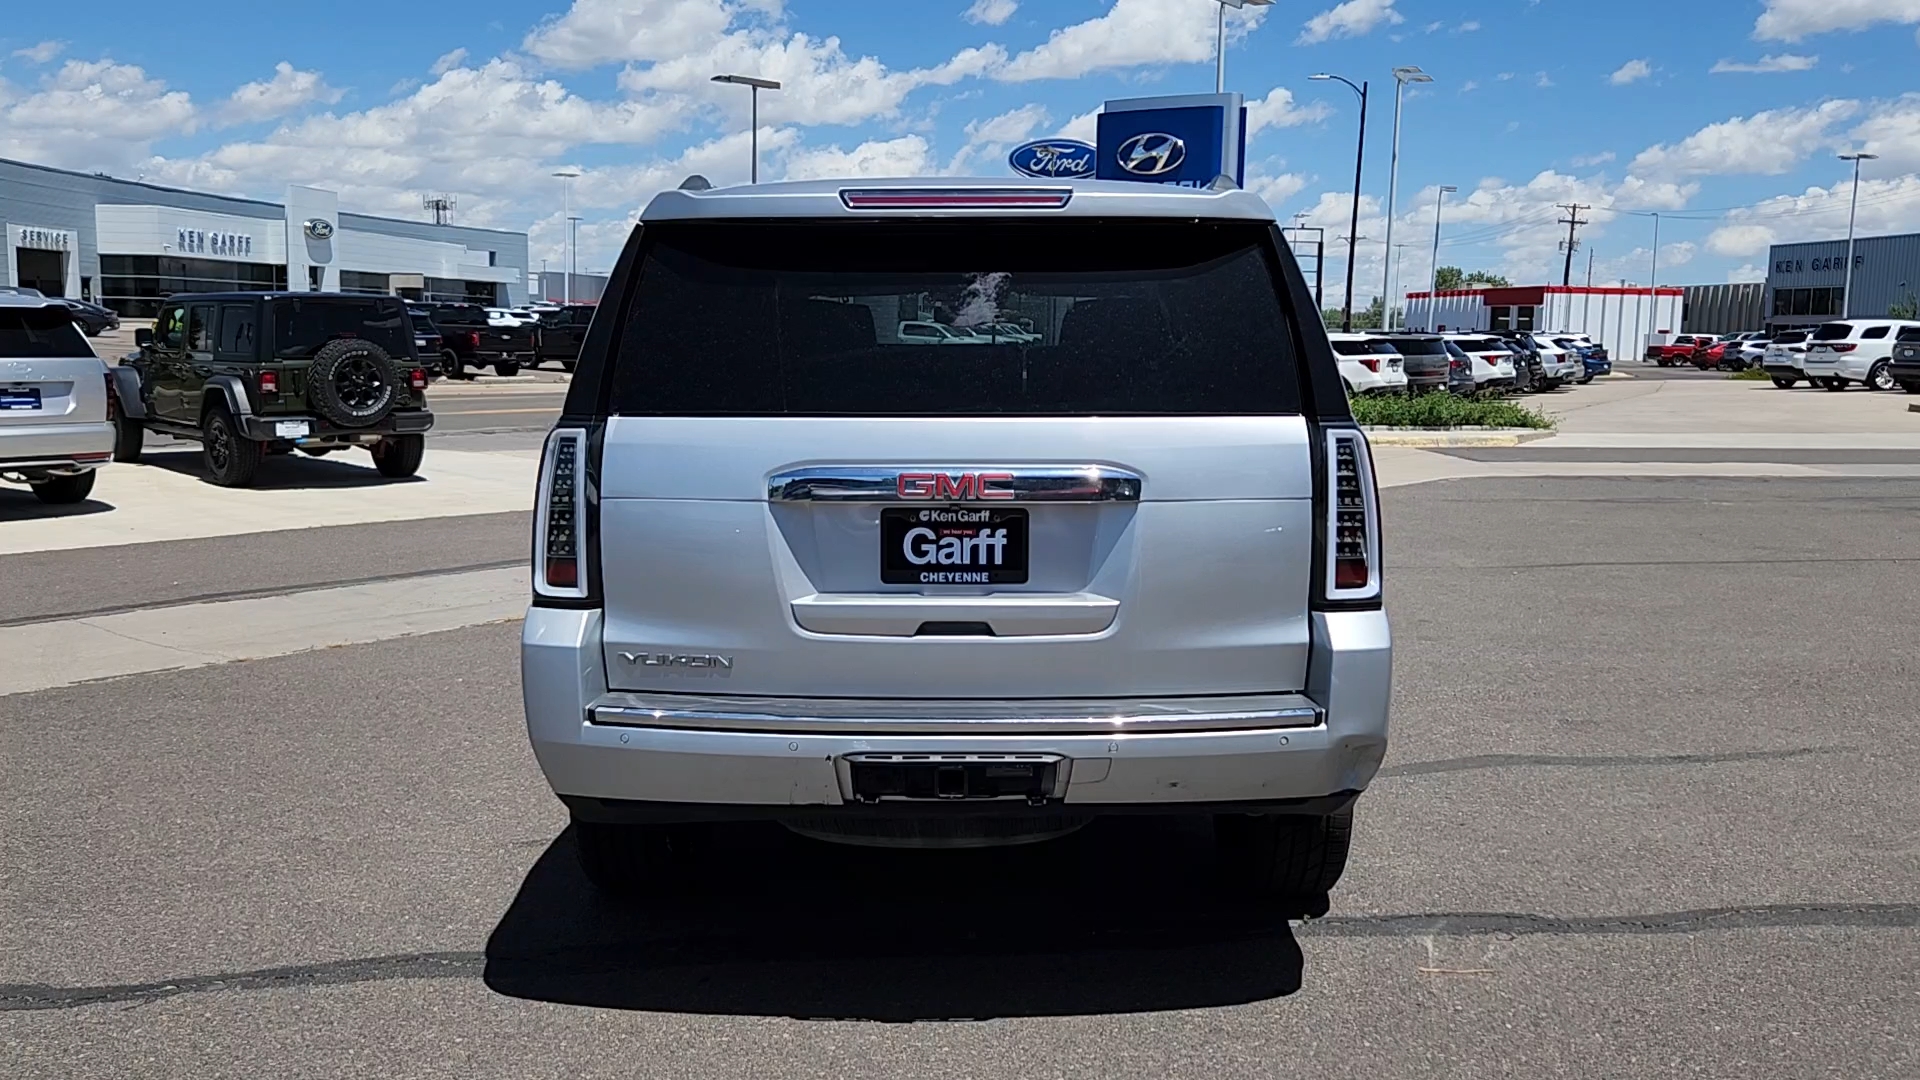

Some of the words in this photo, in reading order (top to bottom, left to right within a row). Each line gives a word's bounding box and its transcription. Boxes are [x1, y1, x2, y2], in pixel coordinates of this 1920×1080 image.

[1030, 147, 1090, 174] Ford
[21, 229, 68, 244] SERVICE
[178, 229, 204, 245] KEN
[210, 232, 251, 248] GARFF
[1775, 258, 1804, 274] KEN
[897, 472, 1016, 500] GMC
[931, 510, 957, 523] Ken
[958, 510, 990, 523] Garff
[903, 527, 1007, 565] Garff
[920, 572, 989, 583] CHEYENNE
[617, 651, 734, 668] YUKON
